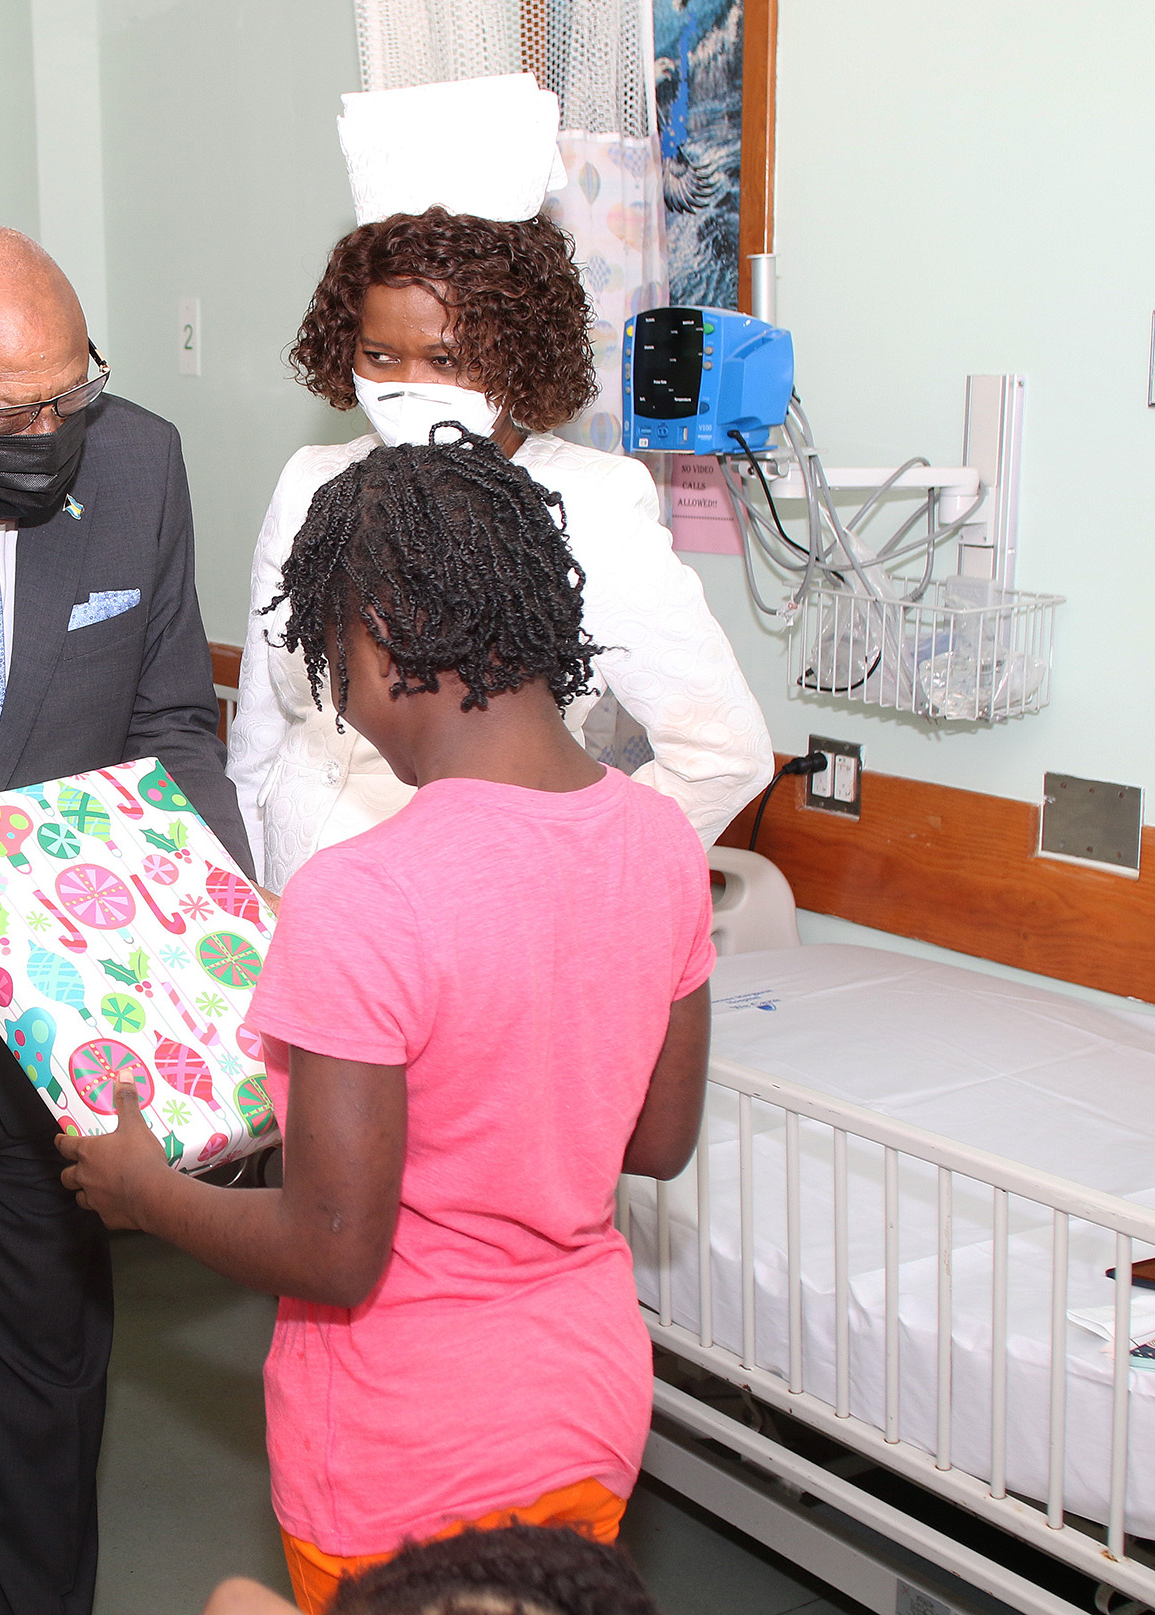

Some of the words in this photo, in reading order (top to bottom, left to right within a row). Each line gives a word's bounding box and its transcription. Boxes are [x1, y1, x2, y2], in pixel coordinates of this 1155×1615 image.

[183, 324, 193, 350] 2
[681, 465, 691, 474] NO
[693, 464, 714, 474] VIDEO
[682, 481, 706, 490] CALLS
[677, 498, 718, 509] ALLOWED!!
